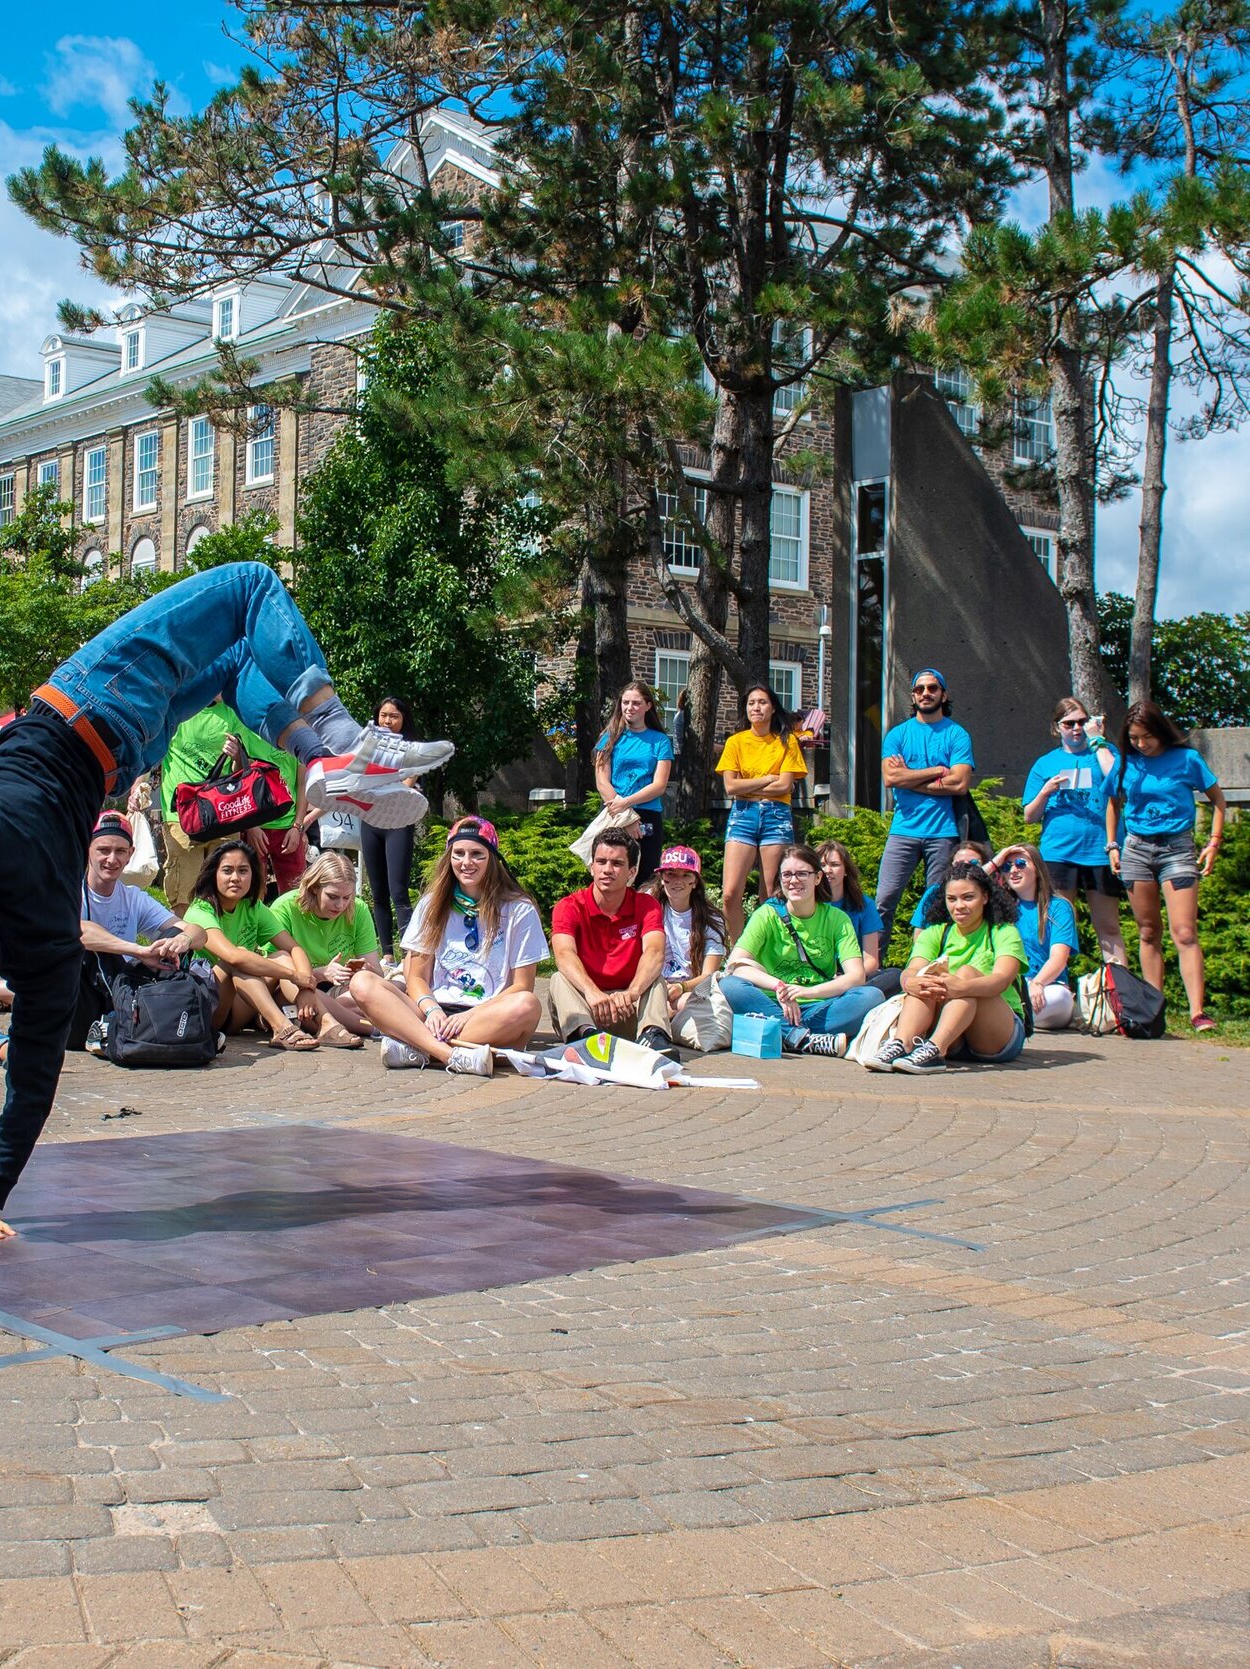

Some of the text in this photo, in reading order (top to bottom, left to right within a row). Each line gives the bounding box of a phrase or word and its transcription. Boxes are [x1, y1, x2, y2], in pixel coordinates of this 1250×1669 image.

[218, 794, 251, 812] GoodLife
[221, 804, 253, 819] FITNESS
[332, 811, 354, 830] 94
[665, 851, 688, 864] DSU
